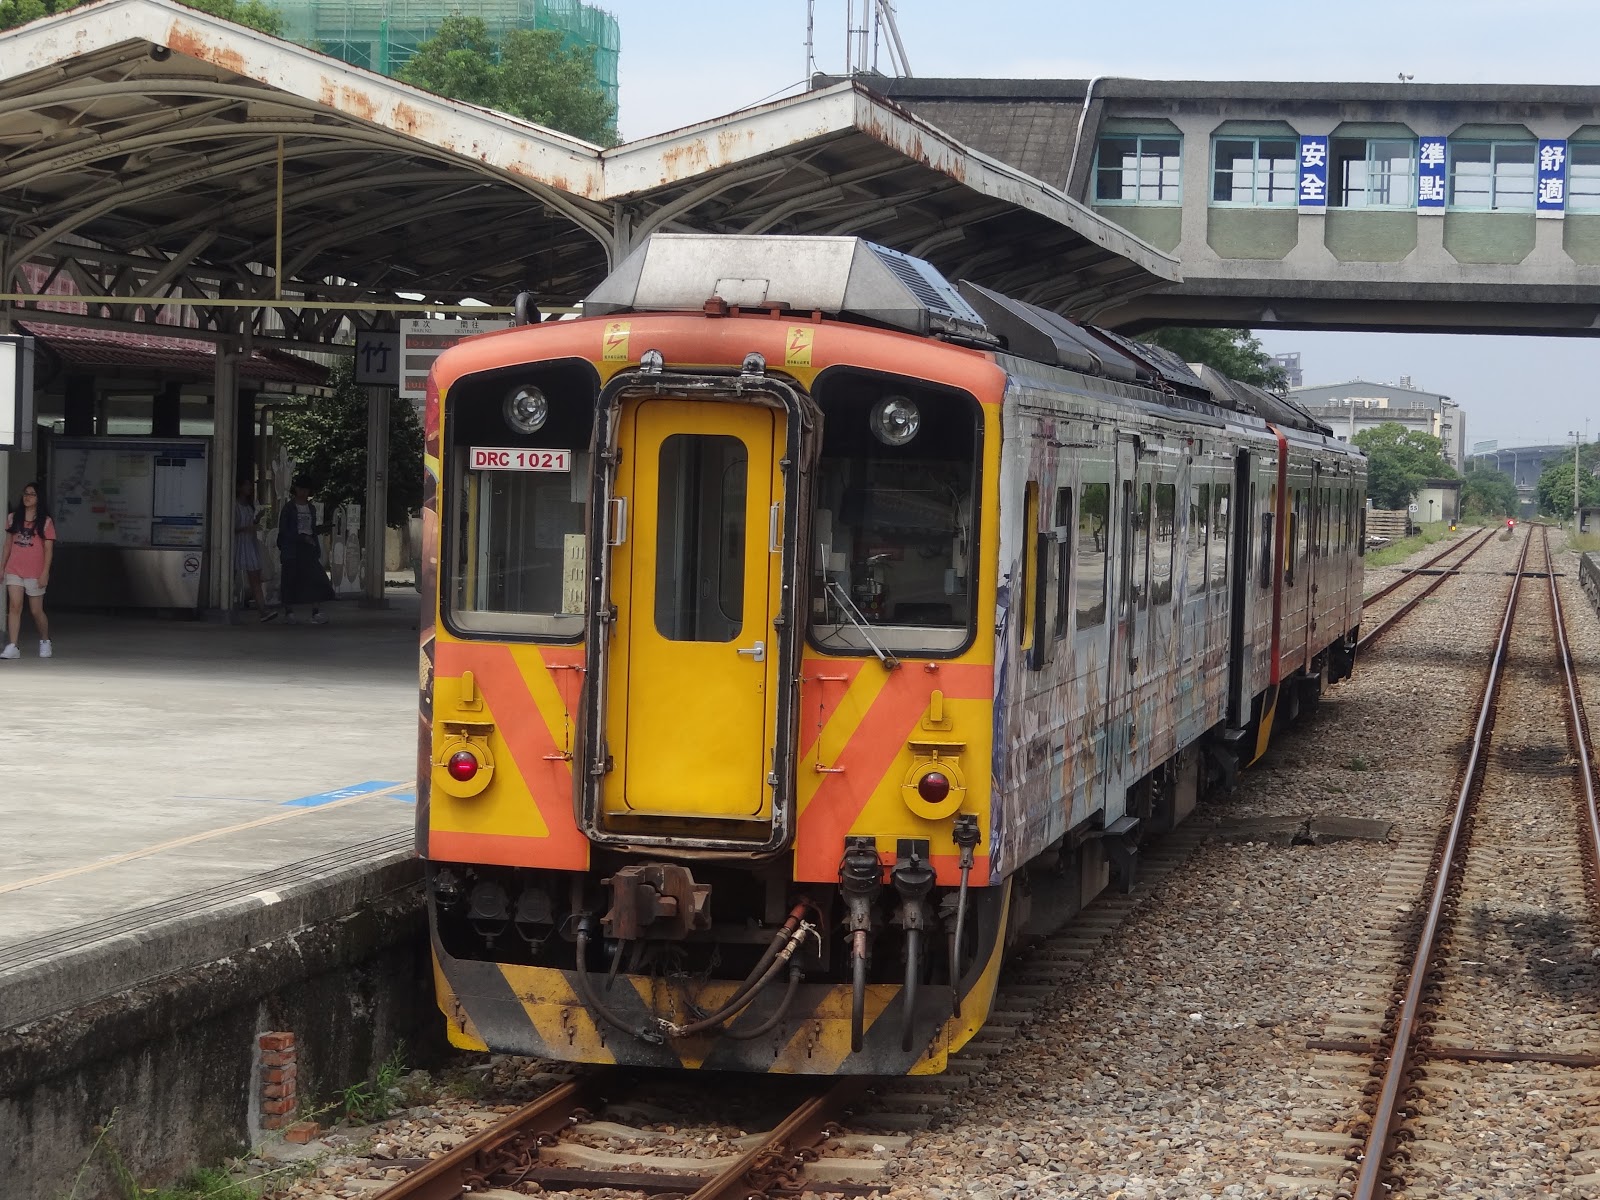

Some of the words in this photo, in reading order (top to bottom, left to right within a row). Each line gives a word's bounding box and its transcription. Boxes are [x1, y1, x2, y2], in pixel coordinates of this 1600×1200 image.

[1300, 142, 1326, 200] 安全
[1419, 142, 1445, 201] 準點
[1539, 145, 1565, 204] 舒適
[360, 340, 392, 373] 竹
[475, 451, 510, 466] DRC
[516, 453, 564, 468] 1021
